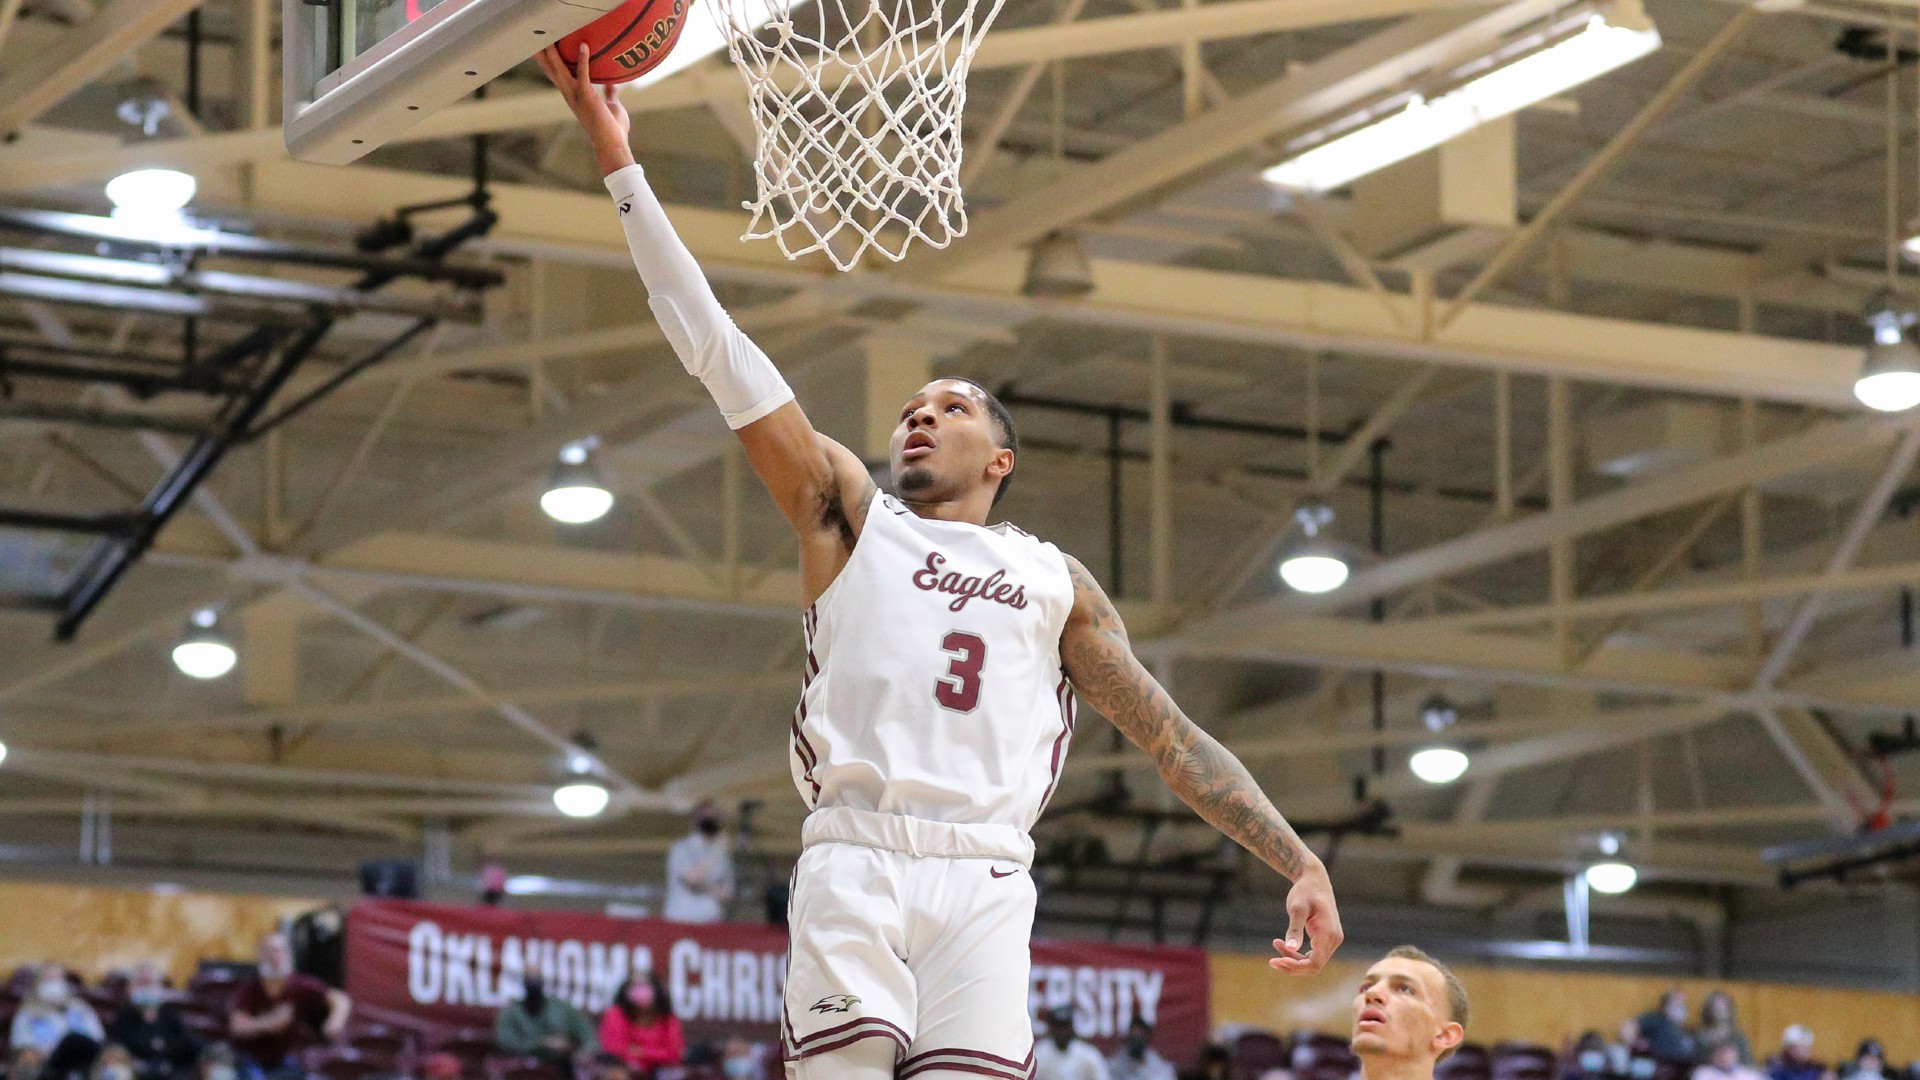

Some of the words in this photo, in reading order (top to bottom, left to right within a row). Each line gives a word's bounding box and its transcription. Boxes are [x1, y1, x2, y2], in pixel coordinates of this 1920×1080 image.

[612, 0, 684, 69] Wilso
[912, 551, 1028, 612] Eagles
[932, 628, 988, 715] 3
